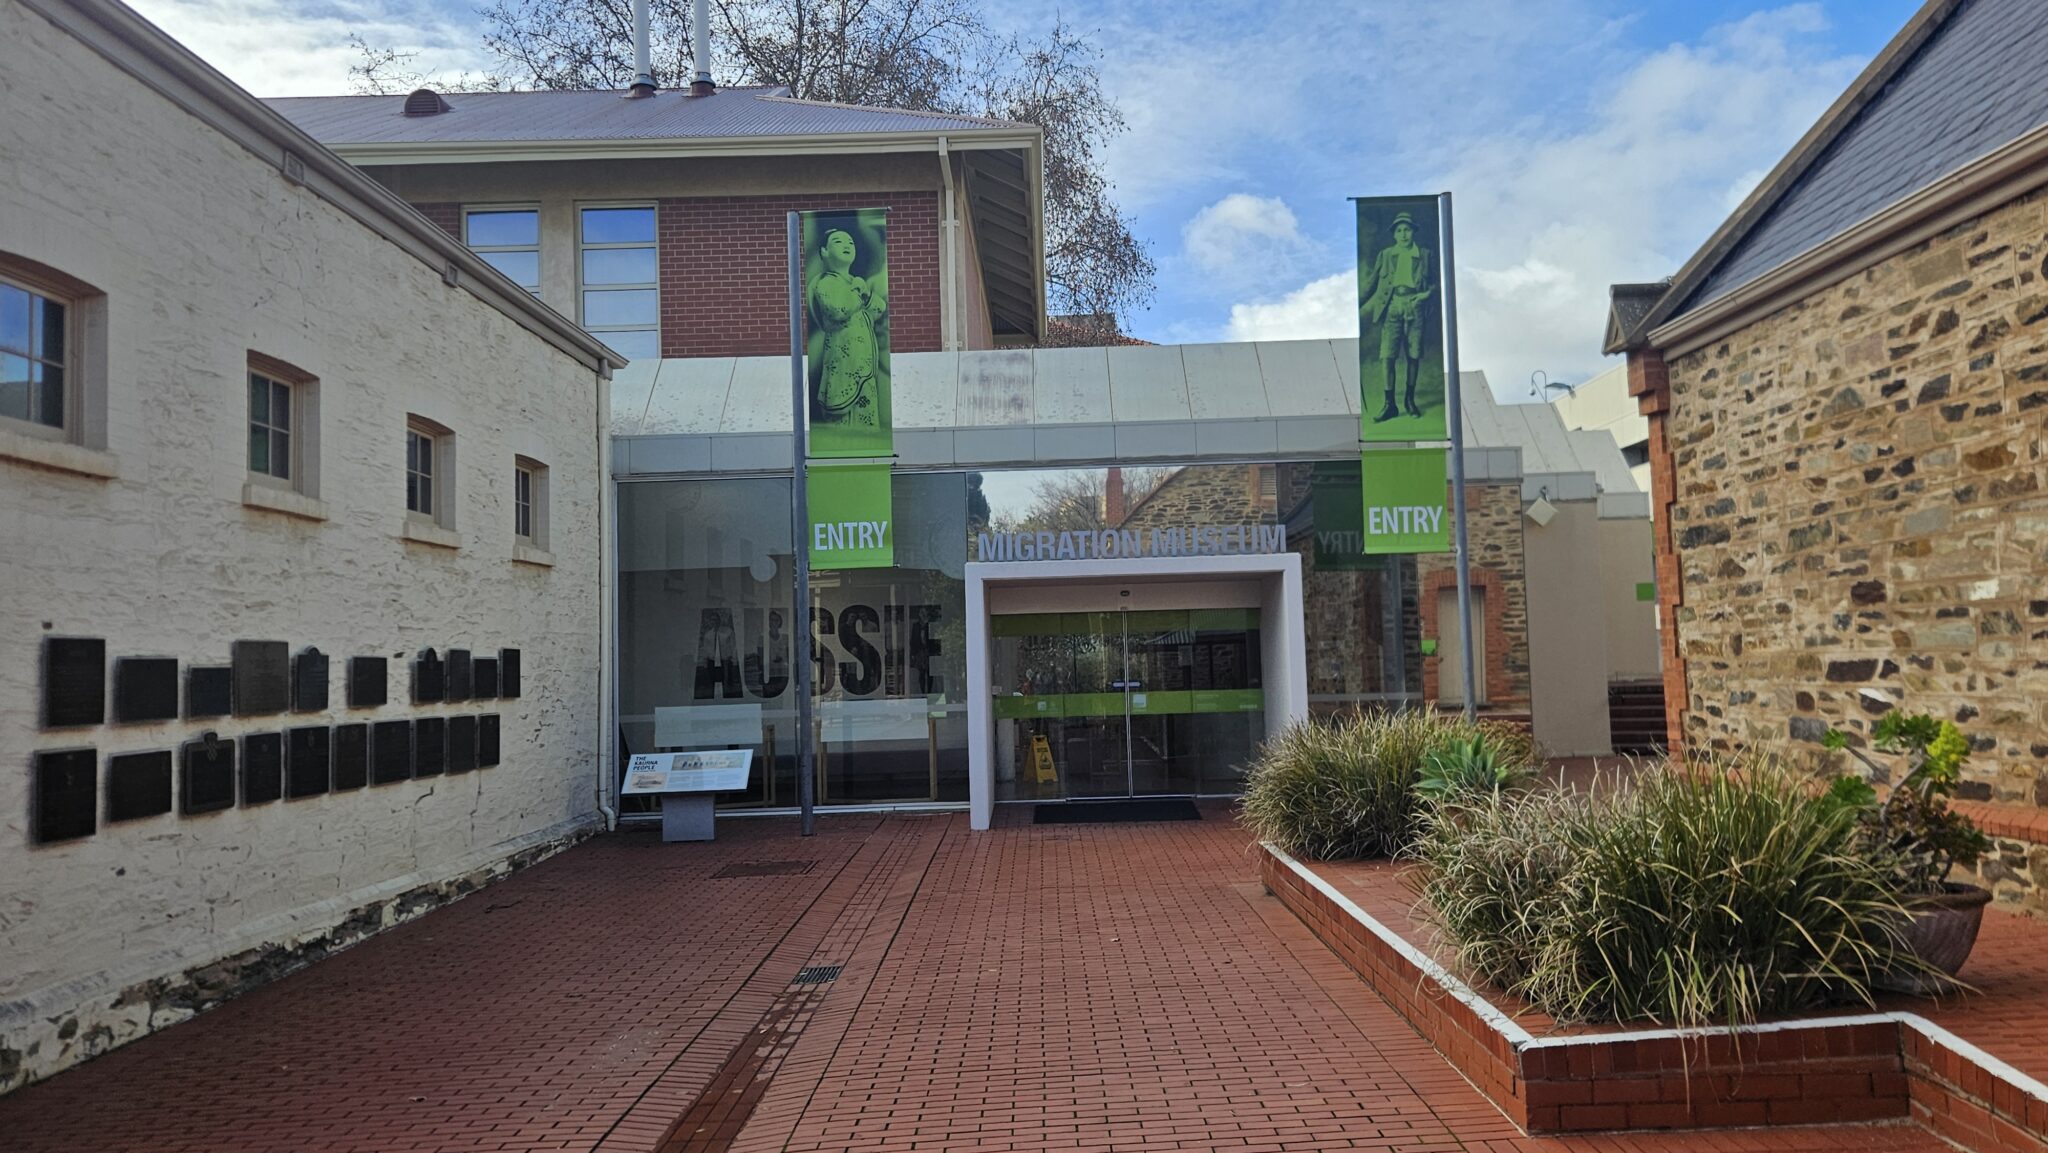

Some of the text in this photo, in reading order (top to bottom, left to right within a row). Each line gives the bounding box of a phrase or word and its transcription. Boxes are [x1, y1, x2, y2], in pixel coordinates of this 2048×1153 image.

[814, 521, 888, 551] ENTRY
[1368, 505, 1443, 535] ENTRY
[978, 524, 1287, 562] MIGRATION MUSEUM
[693, 604, 942, 699] AUSSIE
